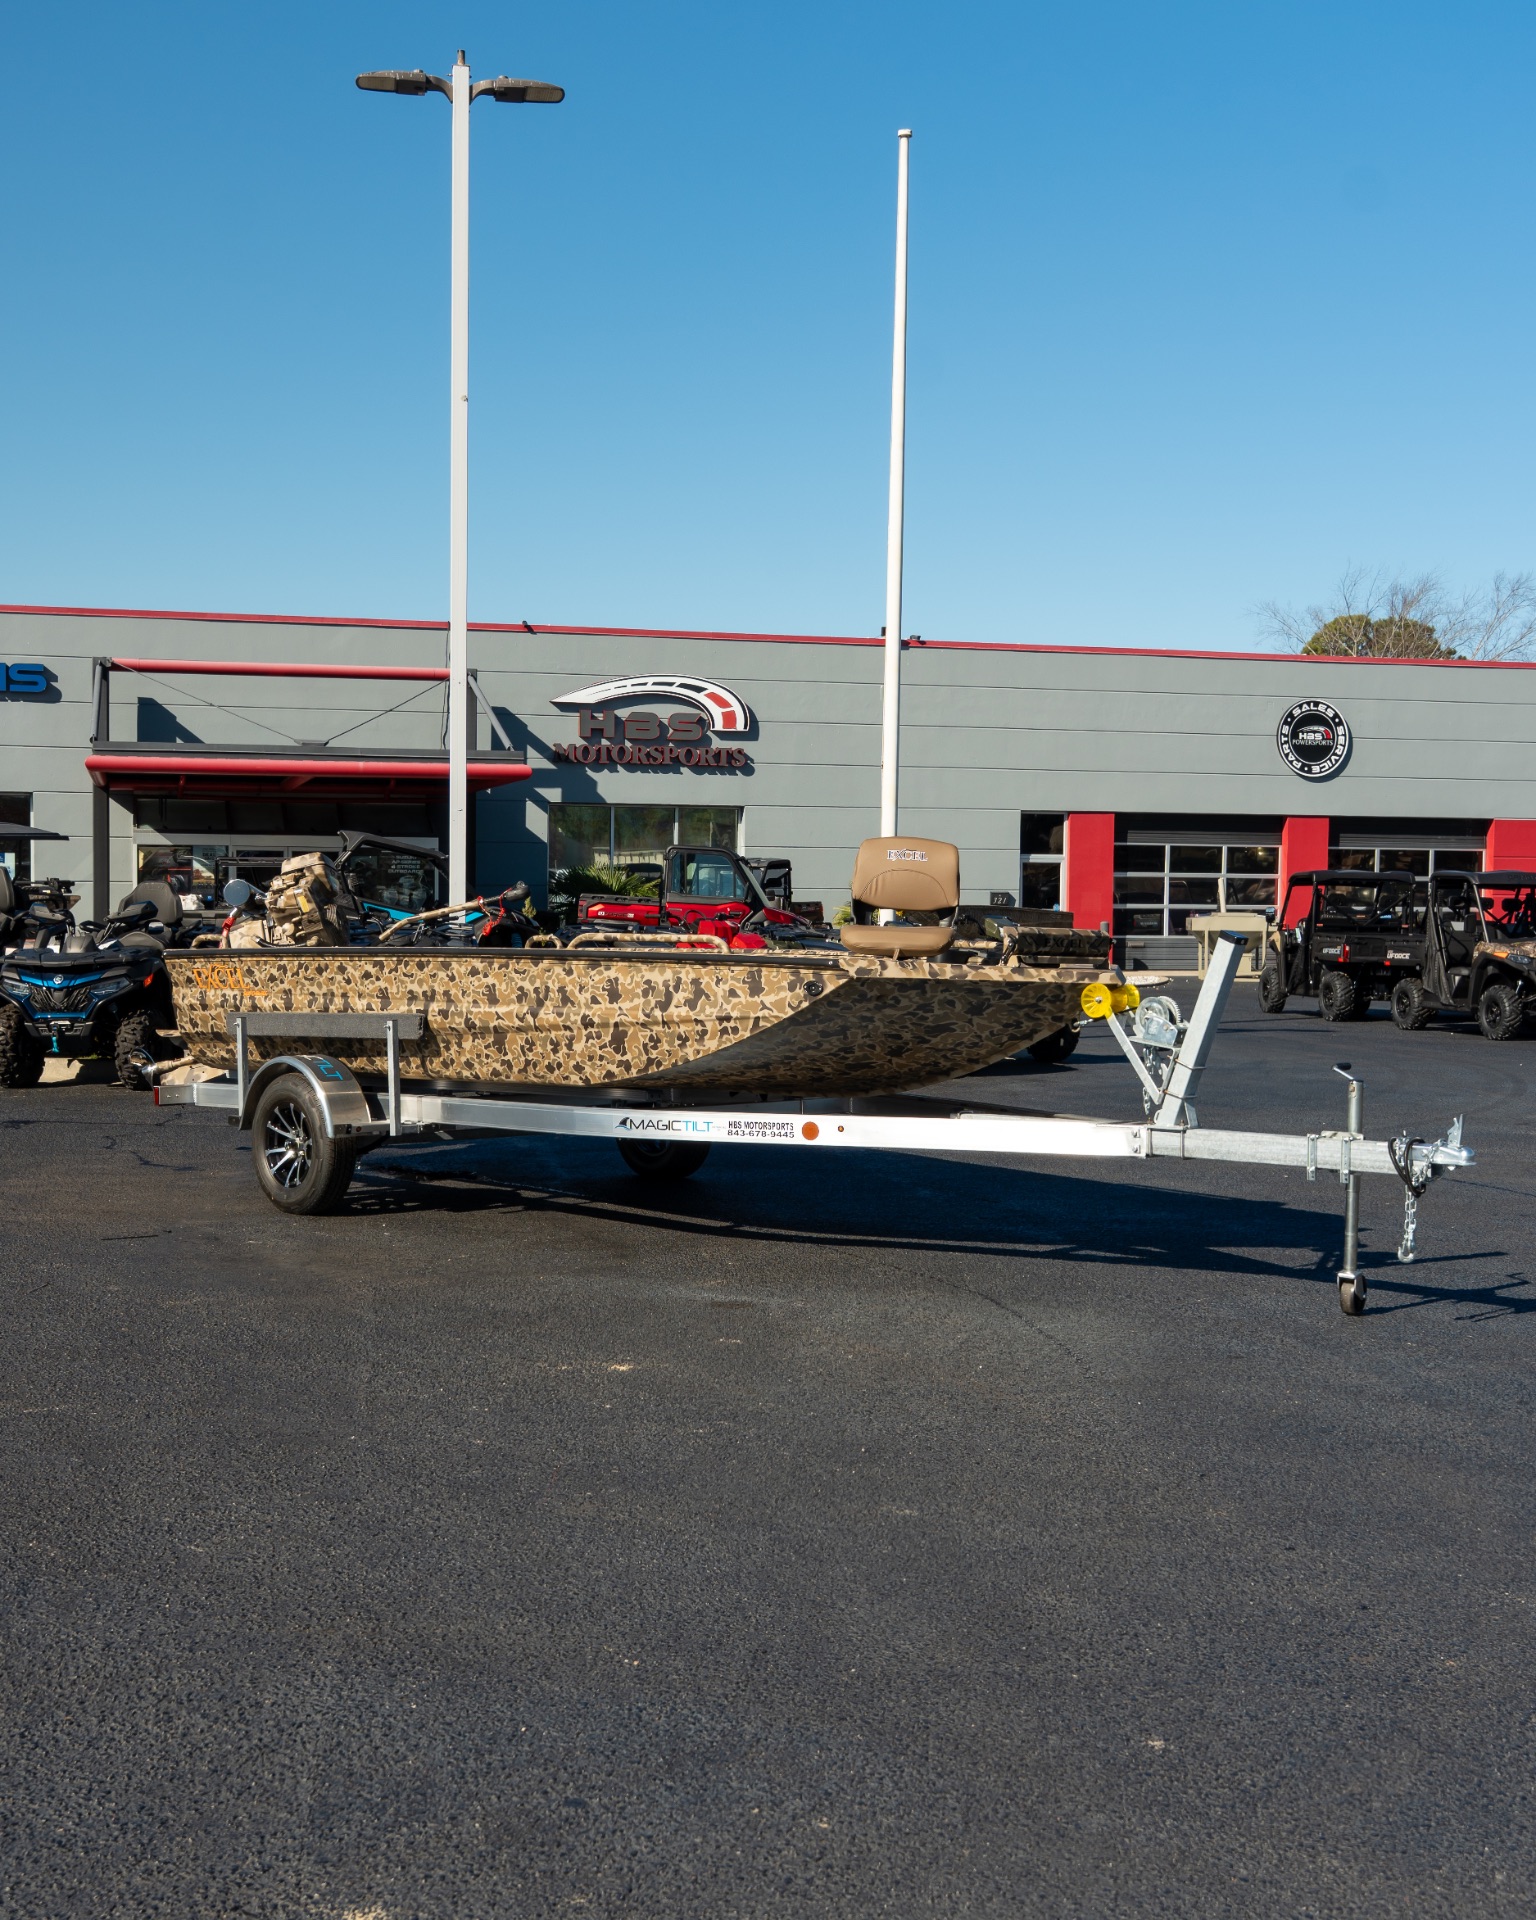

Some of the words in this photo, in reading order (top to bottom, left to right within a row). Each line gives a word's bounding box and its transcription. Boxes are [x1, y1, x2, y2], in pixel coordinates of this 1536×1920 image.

[1292, 702, 1335, 718] SALES
[578, 709, 702, 741] HBS
[1298, 732, 1322, 740] HBS
[553, 743, 746, 767] MOTORSPORTS
[1281, 724, 1302, 769] PARTS
[1310, 725, 1346, 774] SERVICE
[886, 848, 929, 862] EXCEL
[192, 963, 251, 993] EXCEL
[629, 1118, 713, 1132] MAGICTILT
[728, 1120, 742, 1130] HBS
[744, 1121, 794, 1131] MOTORSPORTS
[727, 1129, 795, 1139] 843-678-9445
